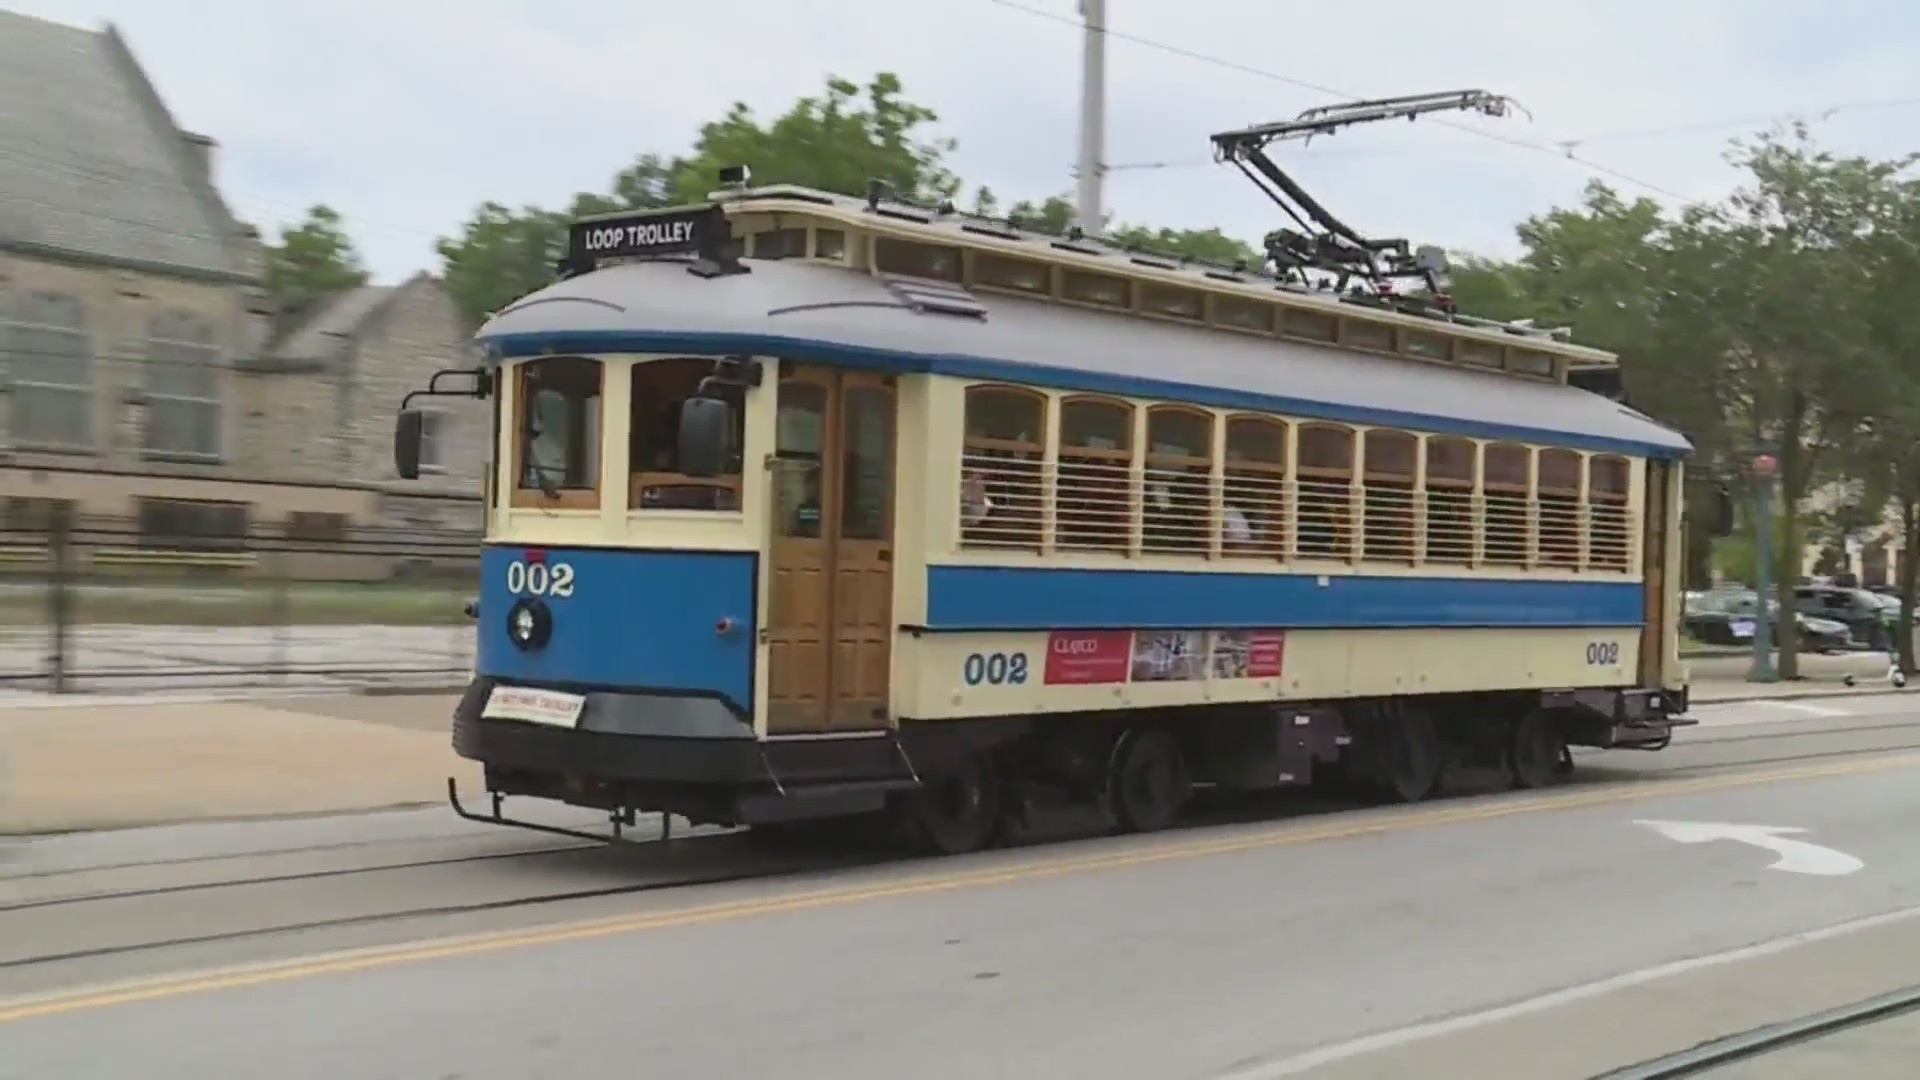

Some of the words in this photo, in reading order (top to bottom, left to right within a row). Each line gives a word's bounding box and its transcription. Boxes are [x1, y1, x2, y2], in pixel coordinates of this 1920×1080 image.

[586, 228, 624, 250] LOOP
[626, 221, 693, 246] TROLLEY
[507, 560, 574, 597] 002
[964, 652, 1028, 686] 002
[1586, 642, 1619, 665] 002
